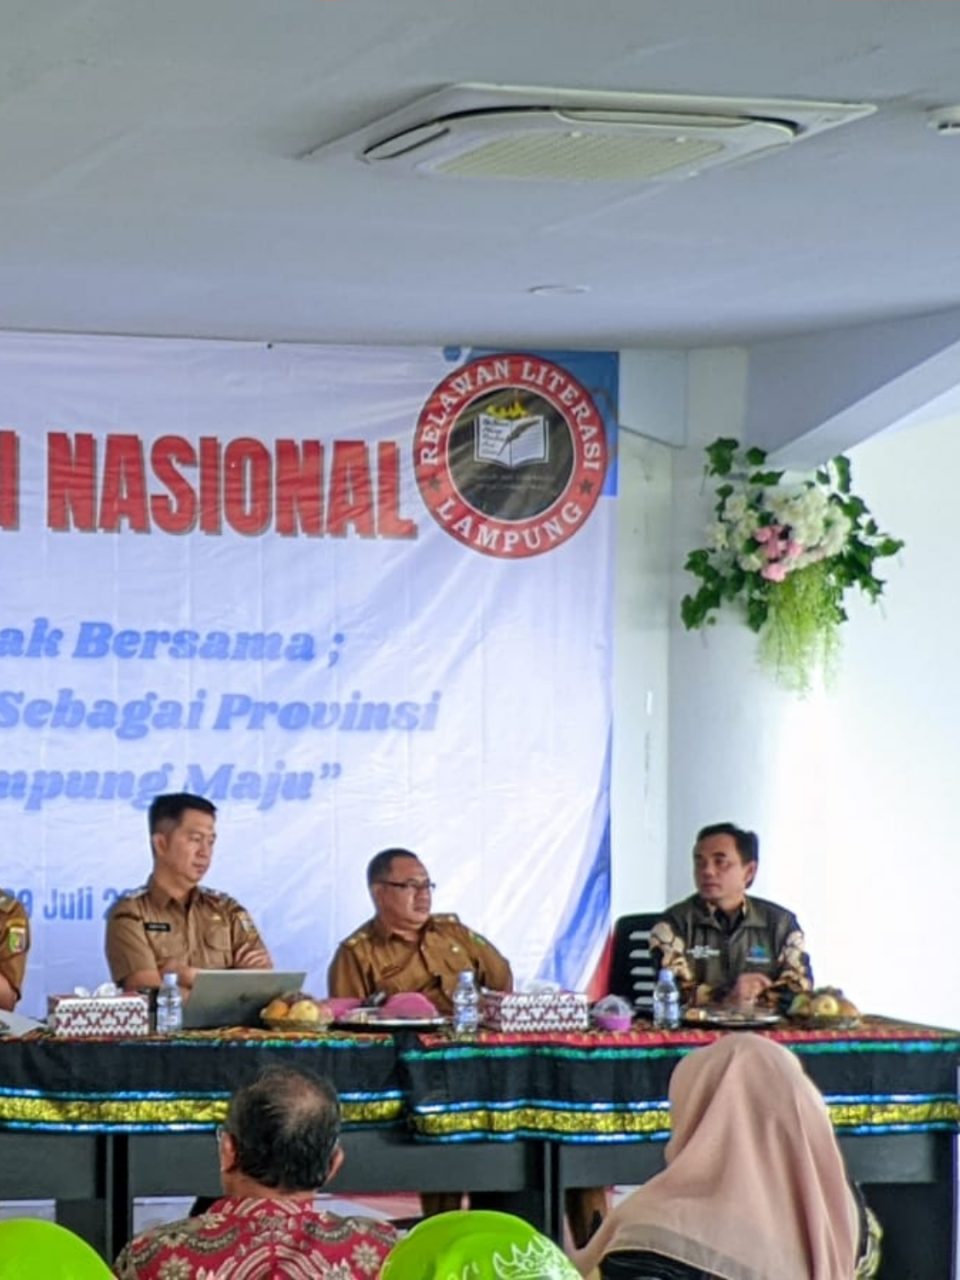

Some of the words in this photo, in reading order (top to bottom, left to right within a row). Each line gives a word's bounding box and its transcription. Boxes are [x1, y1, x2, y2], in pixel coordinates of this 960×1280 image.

[420, 359, 510, 465] RELAWAN
[521, 360, 600, 470] LITERASI
[47, 431, 418, 540] NASIONAL
[438, 498, 583, 552] LAMPUNG
[213, 690, 442, 734] Provinsi
[44, 887, 93, 920] Juli
